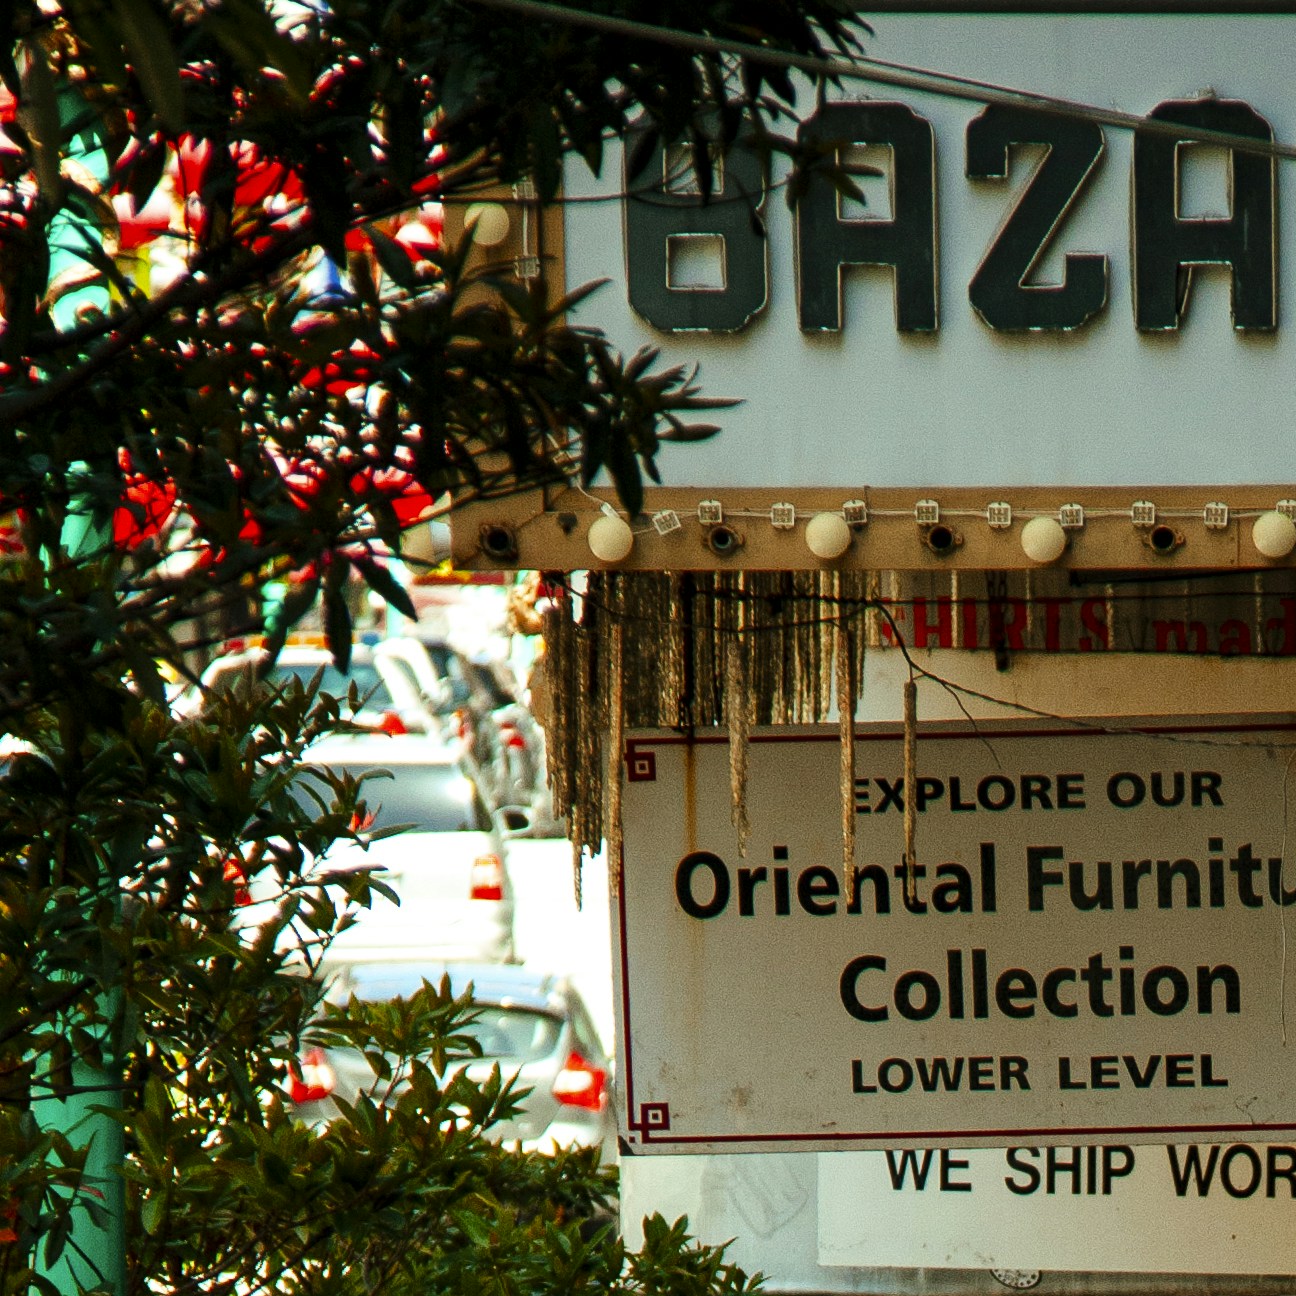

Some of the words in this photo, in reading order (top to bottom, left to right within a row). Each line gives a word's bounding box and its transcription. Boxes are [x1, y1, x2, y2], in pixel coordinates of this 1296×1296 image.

[853, 771, 1086, 813] EXPLORE
[1106, 771, 1224, 808] OUR
[675, 841, 995, 920] Oriental
[840, 946, 1241, 1023] Collection
[852, 1056, 1030, 1094] LOWER
[1058, 1054, 1228, 1090] LEVEL
[885, 1149, 973, 1192] WE
[1005, 1145, 1136, 1196] SHIP
